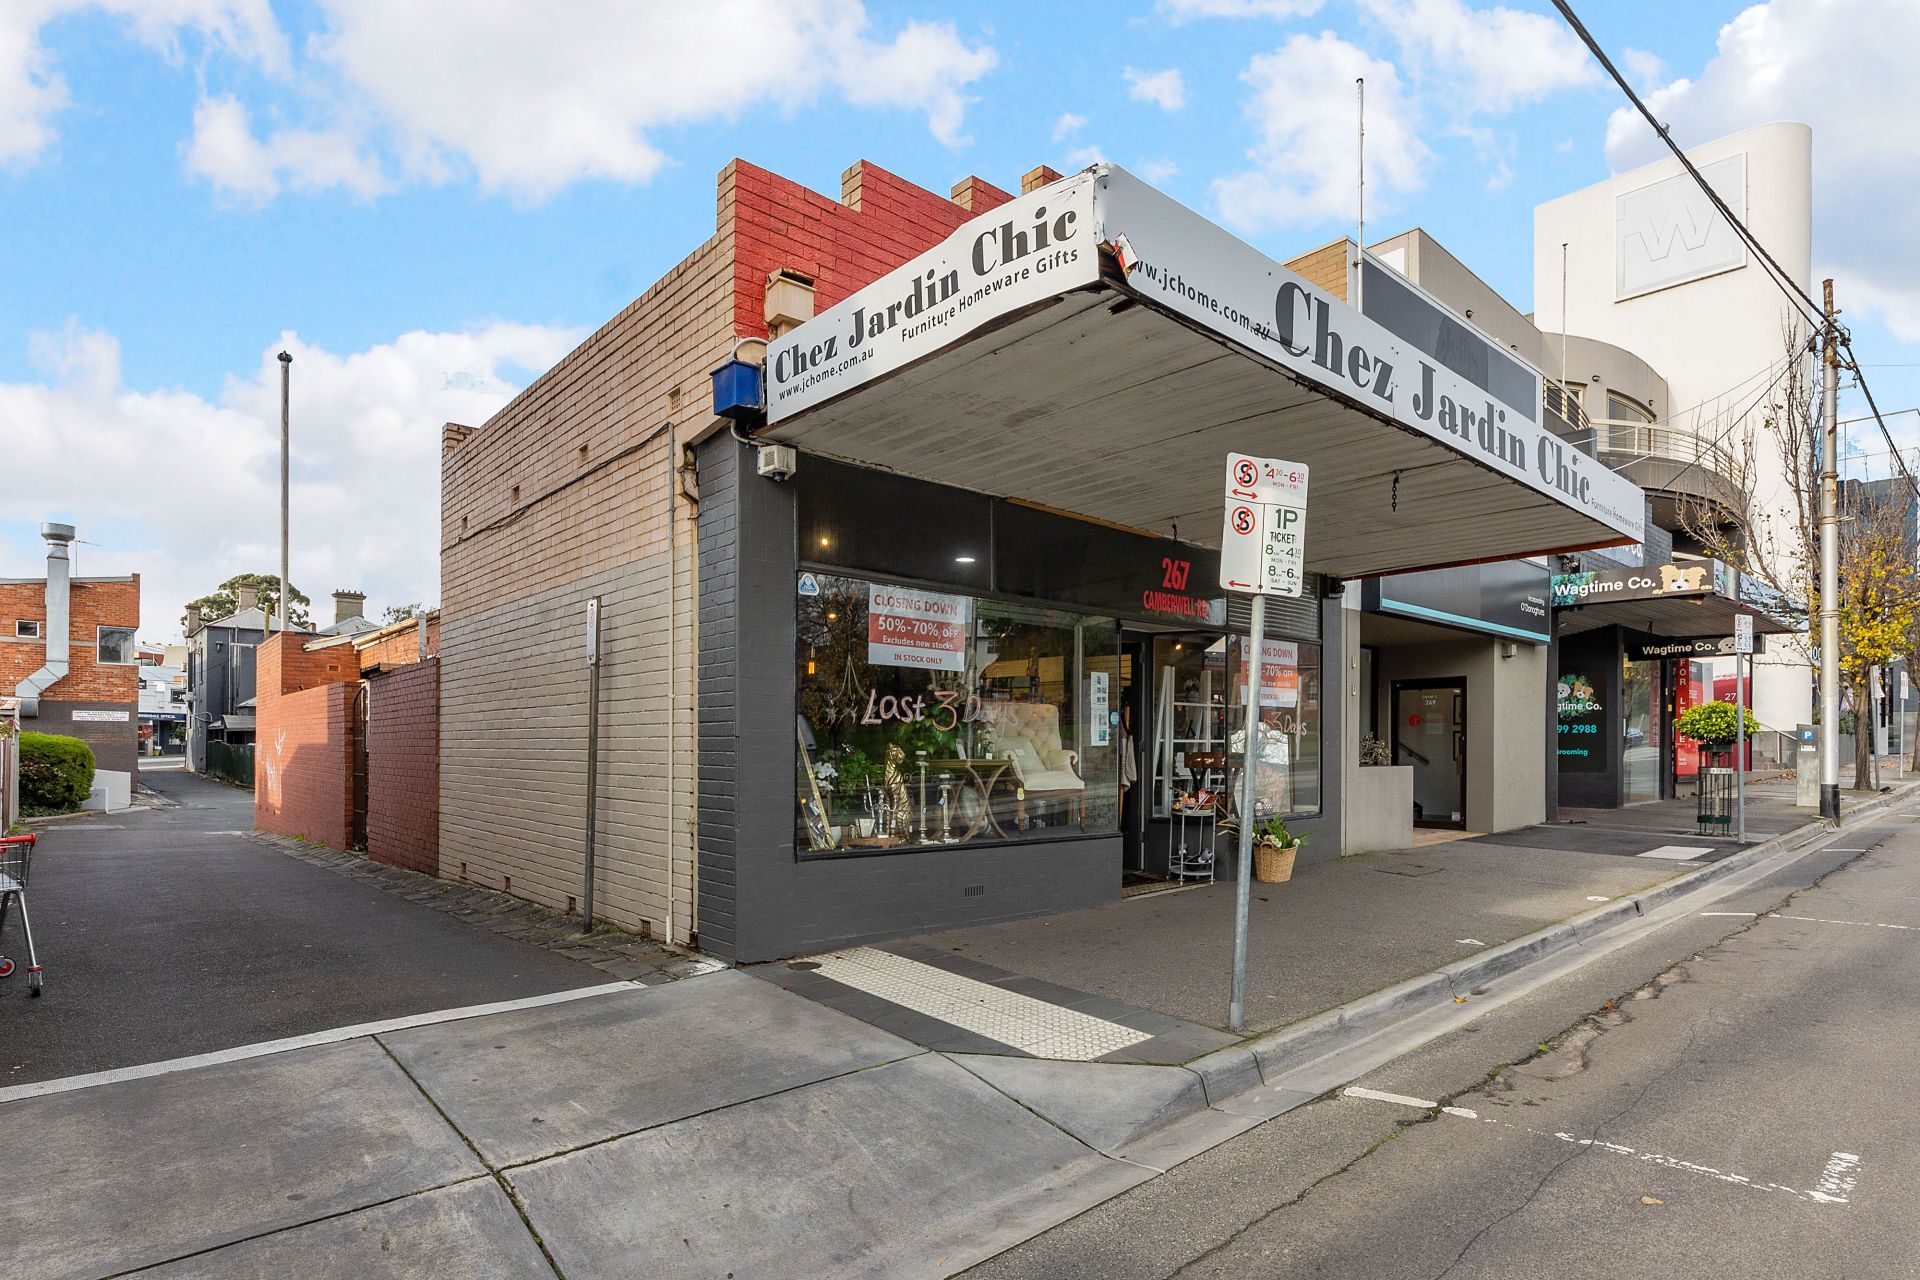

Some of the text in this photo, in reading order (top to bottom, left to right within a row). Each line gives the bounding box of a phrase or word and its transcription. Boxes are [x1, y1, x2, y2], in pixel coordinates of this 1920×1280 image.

[775, 206, 1078, 385] Chez Jardin Chic
[901, 248, 1078, 343] Furniture Homeware Gifts
[1134, 260, 1270, 341] ww.jchome.com.au
[778, 347, 875, 401] www.jchome.com.au
[1275, 281, 1395, 403] Chez
[1412, 360, 1527, 472] Jardin
[1537, 435, 1590, 505] Chic
[1275, 508, 1299, 530] 1P
[1270, 531, 1297, 545] TICKET
[1162, 557, 1190, 590] 267
[1554, 577, 1656, 597] Wagtime Co.
[874, 594, 958, 616] CLOSING DOWN
[1143, 591, 1196, 616] CAMBERWELL
[882, 635, 954, 650] Excludes new stocks
[942, 628, 959, 638] OFF
[894, 653, 943, 665] IN STOCK ONLY
[1273, 648, 1293, 659] DOWN
[1642, 642, 1715, 656] Wagtime Co.
[860, 688, 926, 725] Last
[932, 690, 959, 731] 3
[1557, 701, 1602, 712] gtime Co.
[1572, 724, 1597, 734] 2988
[1679, 697, 1687, 743] LEE
[1557, 748, 1588, 756] rooming
